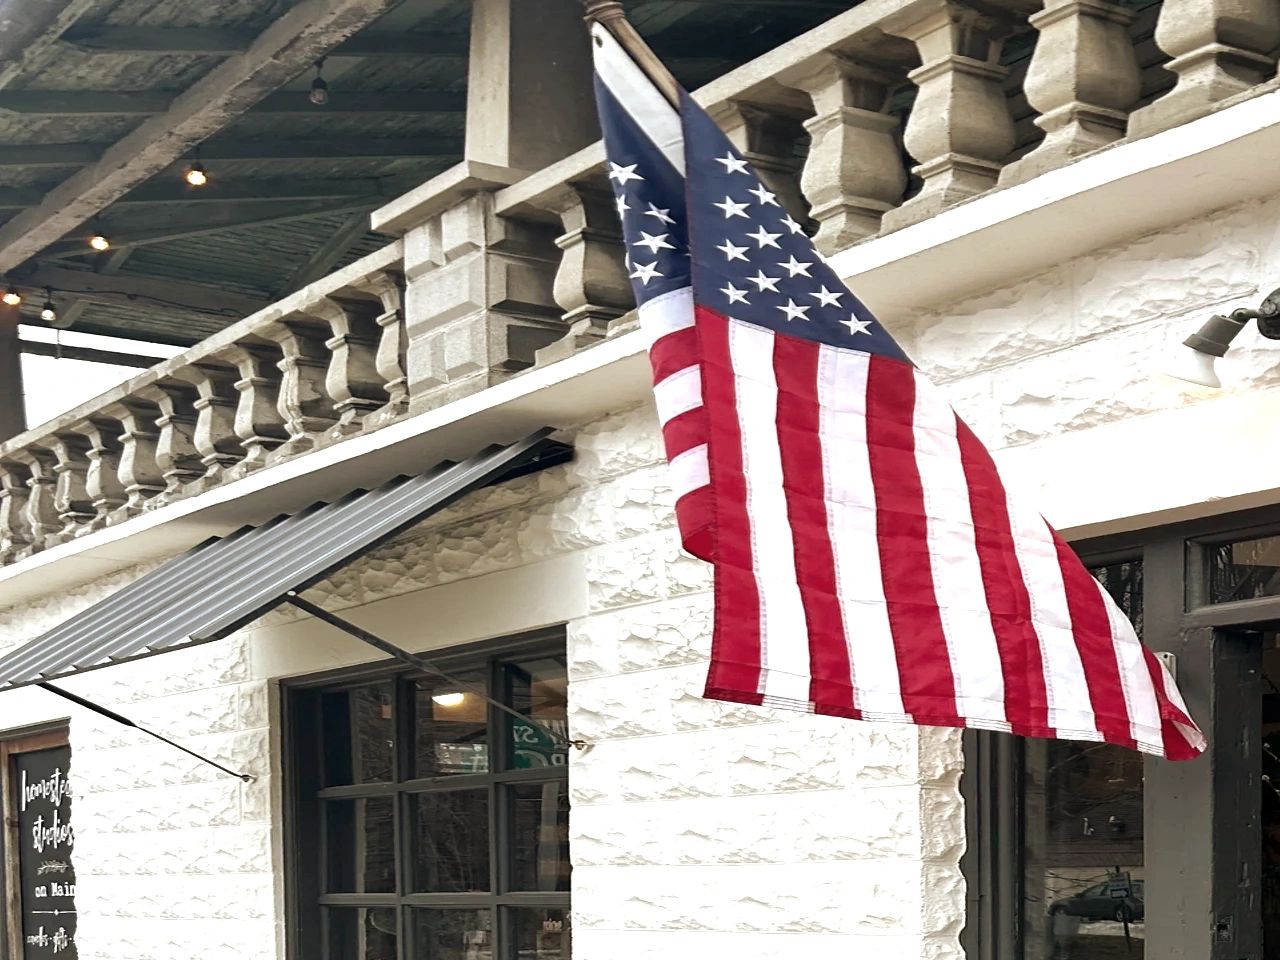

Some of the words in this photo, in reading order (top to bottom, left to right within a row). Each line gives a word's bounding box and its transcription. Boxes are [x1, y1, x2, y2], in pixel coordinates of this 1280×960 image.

[32, 809, 74, 853] studios
[35, 886, 47, 898] on
[51, 882, 76, 897] Main
